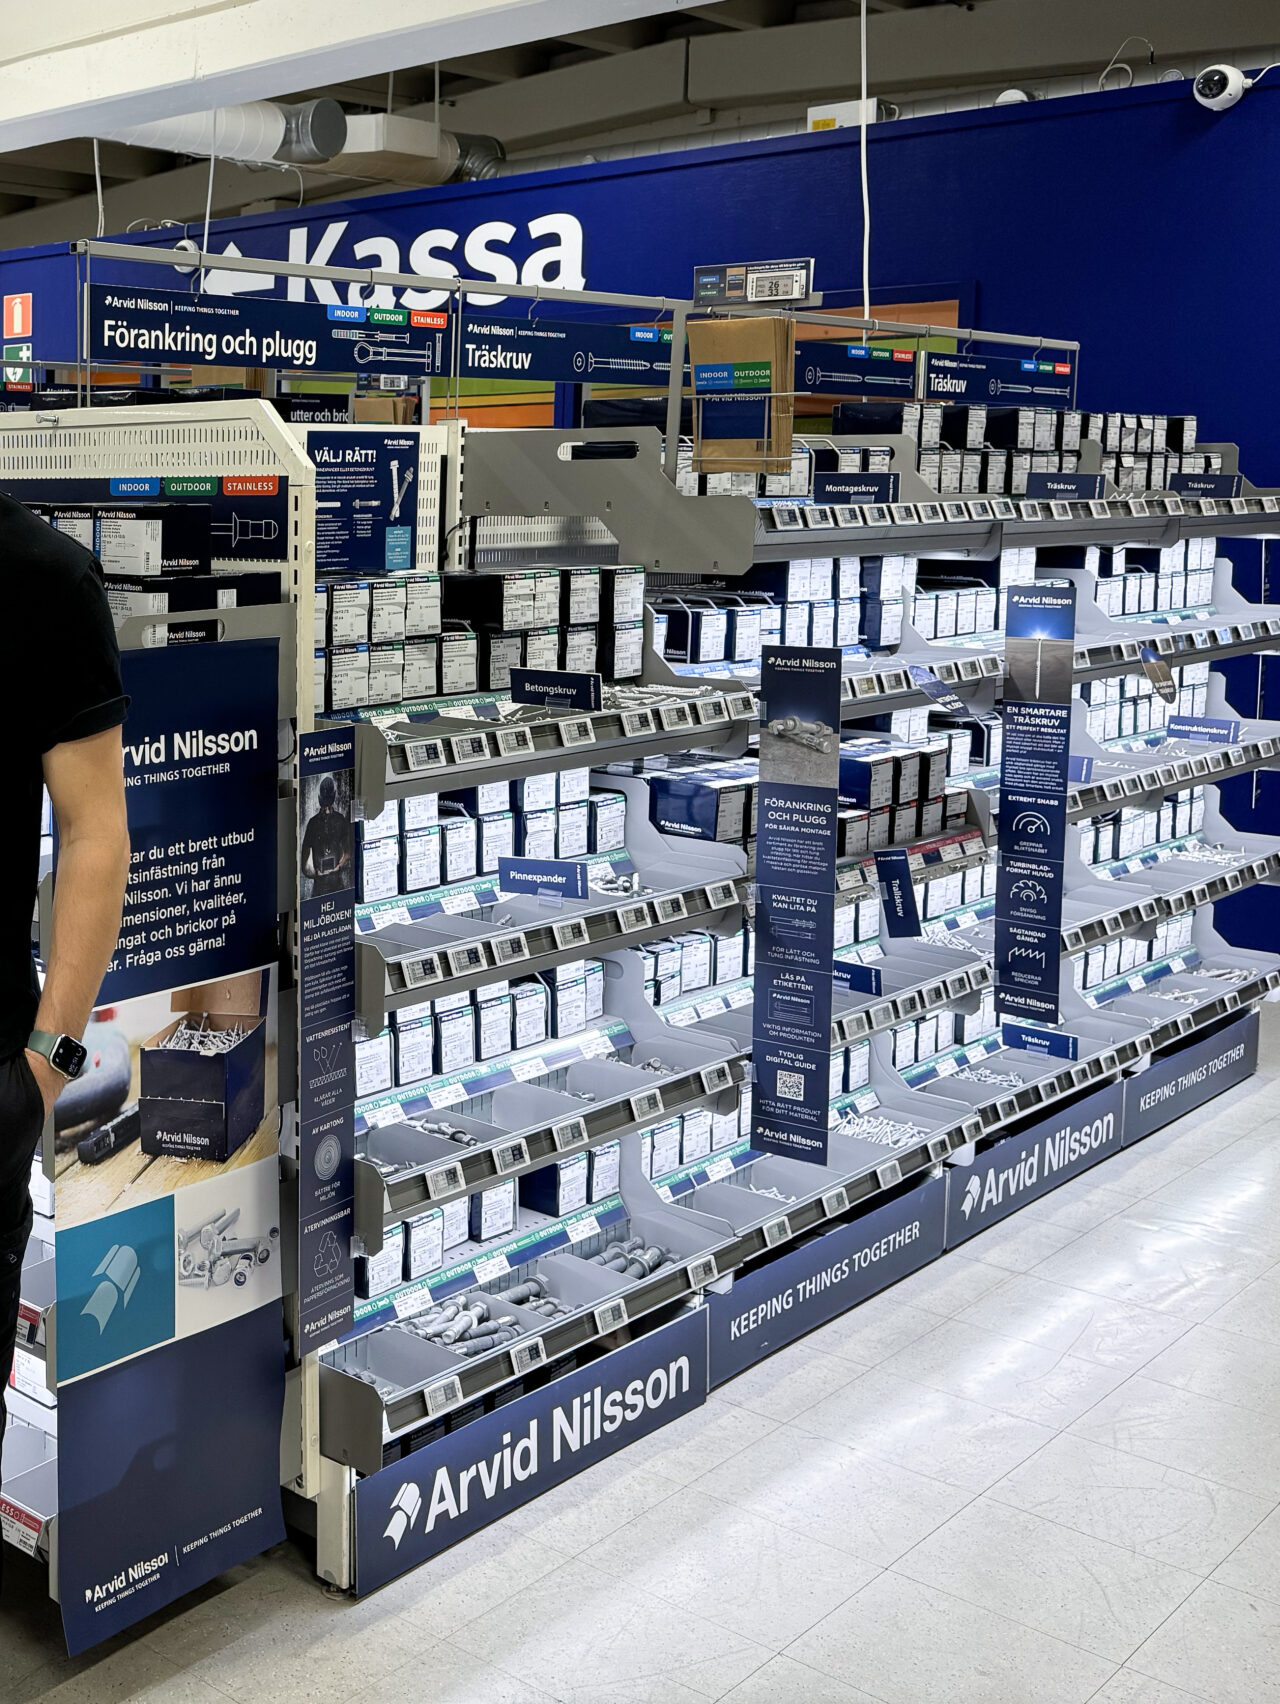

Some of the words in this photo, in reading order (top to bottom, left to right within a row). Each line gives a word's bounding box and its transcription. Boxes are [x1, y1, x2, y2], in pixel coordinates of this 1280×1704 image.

[287, 212, 586, 309] Kassa
[334, 310, 358, 318] INDOOR
[374, 313, 402, 322] OUTDOOR
[414, 315, 444, 324] STAINLESS
[104, 320, 216, 360] Förankring
[222, 328, 256, 355] och
[262, 330, 317, 366] plugg
[465, 344, 532, 370] Träskruv
[930, 374, 966, 393] Träskruv
[291, 409, 313, 422] utter
[314, 409, 331, 422] och
[333, 409, 348, 422] bric
[315, 447, 342, 462] VÄLJ
[346, 447, 376, 462] RÄTT!
[170, 483, 211, 491] OUTDOOR
[227, 482, 273, 491] STAINLESS
[825, 485, 879, 493] Montageskruv
[1019, 596, 1040, 604] Arvid
[1042, 596, 1072, 605] Nilsson
[775, 657, 800, 667] Arvid
[802, 659, 836, 668] Nilsson
[525, 683, 577, 696] Betongskruv
[401, 704, 428, 713] OUTDOOR
[454, 698, 478, 707] OUTDOOR
[1021, 707, 1068, 717] SMARTARE
[1013, 716, 1060, 726] TRÄSKRUV
[122, 736, 165, 768] rvid
[174, 728, 258, 760] Nilsson
[309, 746, 326, 756] Arvid
[328, 742, 352, 754] Nilsson
[143, 768, 180, 783] THINGS
[182, 762, 230, 779] TOGETHER
[765, 798, 831, 812] FÖRANKRING
[1008, 795, 1035, 803] EXTREMT
[768, 811, 790, 821] OCH
[793, 814, 826, 825] PLUGG
[779, 823, 799, 832] SÄKRA
[801, 827, 831, 836] MONTAGE
[128, 862, 198, 885] tsinfästning
[202, 854, 225, 870] från
[509, 871, 567, 883] Pinnexpander
[1006, 867, 1030, 876] FORMAT
[1032, 870, 1054, 878] HUVUD
[124, 888, 172, 906] Nilsson.
[176, 880, 187, 896] Vi
[192, 879, 210, 893] har
[214, 873, 241, 888] ännu
[772, 894, 805, 904] KVALITET
[891, 879, 904, 917] Trallskruv
[120, 904, 190, 927] mensioner,
[194, 891, 246, 912] kvalitéer,
[321, 901, 335, 913] HEJ
[304, 909, 352, 930] MILJÖBOXEN!
[115, 931, 146, 950] ngat
[150, 926, 172, 942] och
[176, 917, 218, 936] brickor
[222, 910, 236, 928] på
[304, 934, 313, 942] HEJ
[314, 932, 320, 940] DÅ
[322, 924, 352, 938] PLASTLÅDAN.
[1016, 934, 1038, 943] GÄNGA
[774, 979, 813, 991] ETIKETTEN!
[796, 974, 806, 983] PÅ
[1005, 993, 1025, 1004] Arvid
[1026, 997, 1055, 1010] Nilsson
[306, 1022, 350, 1042] VATTENRESISTENT
[1021, 1034, 1050, 1045] Träskruv
[766, 1055, 793, 1066] DIGITAL
[794, 1060, 817, 1070] GUIDE
[778, 1050, 804, 1060] TYDLIG
[1140, 1081, 1175, 1112] KEEPING
[1177, 1068, 1206, 1092] THINGS
[1208, 1043, 1245, 1076] TOGETHER
[312, 1127, 319, 1135] AV
[320, 1117, 344, 1133] KARTONG
[162, 1130, 182, 1143] Arvid
[183, 1132, 209, 1146] Nilsson
[764, 1129, 787, 1140] Arvid
[789, 1134, 822, 1148] Nilsson
[981, 1137, 1039, 1213] Arvid
[1043, 1112, 1113, 1176] Nilsson
[304, 1208, 351, 1234] ÅTERVINNINGSBAR
[395, 1283, 422, 1300] OUTDOOR
[447, 1263, 471, 1278] OUTDOOR
[492, 1242, 517, 1257] OUTDOOR
[539, 1223, 563, 1237] OUTDOOR
[581, 1205, 604, 1219] OUTDOOR
[730, 1289, 793, 1341] KEEPING
[797, 1259, 849, 1302] THINGS
[853, 1221, 920, 1272] TOGETHER
[310, 1315, 326, 1333] Arvid
[328, 1304, 351, 1323] Nilsson
[424, 1418, 538, 1534] Arvid
[552, 1356, 689, 1462] Nilsson
[94, 1572, 126, 1602] Arvid
[182, 1535, 208, 1554] KEEPING
[209, 1524, 231, 1540] THINGS
[232, 1508, 262, 1528] TOGETHER
[95, 1597, 116, 1612] KEEPING
[117, 1587, 134, 1602] THINGS
[135, 1573, 160, 1594] TOGETHER
